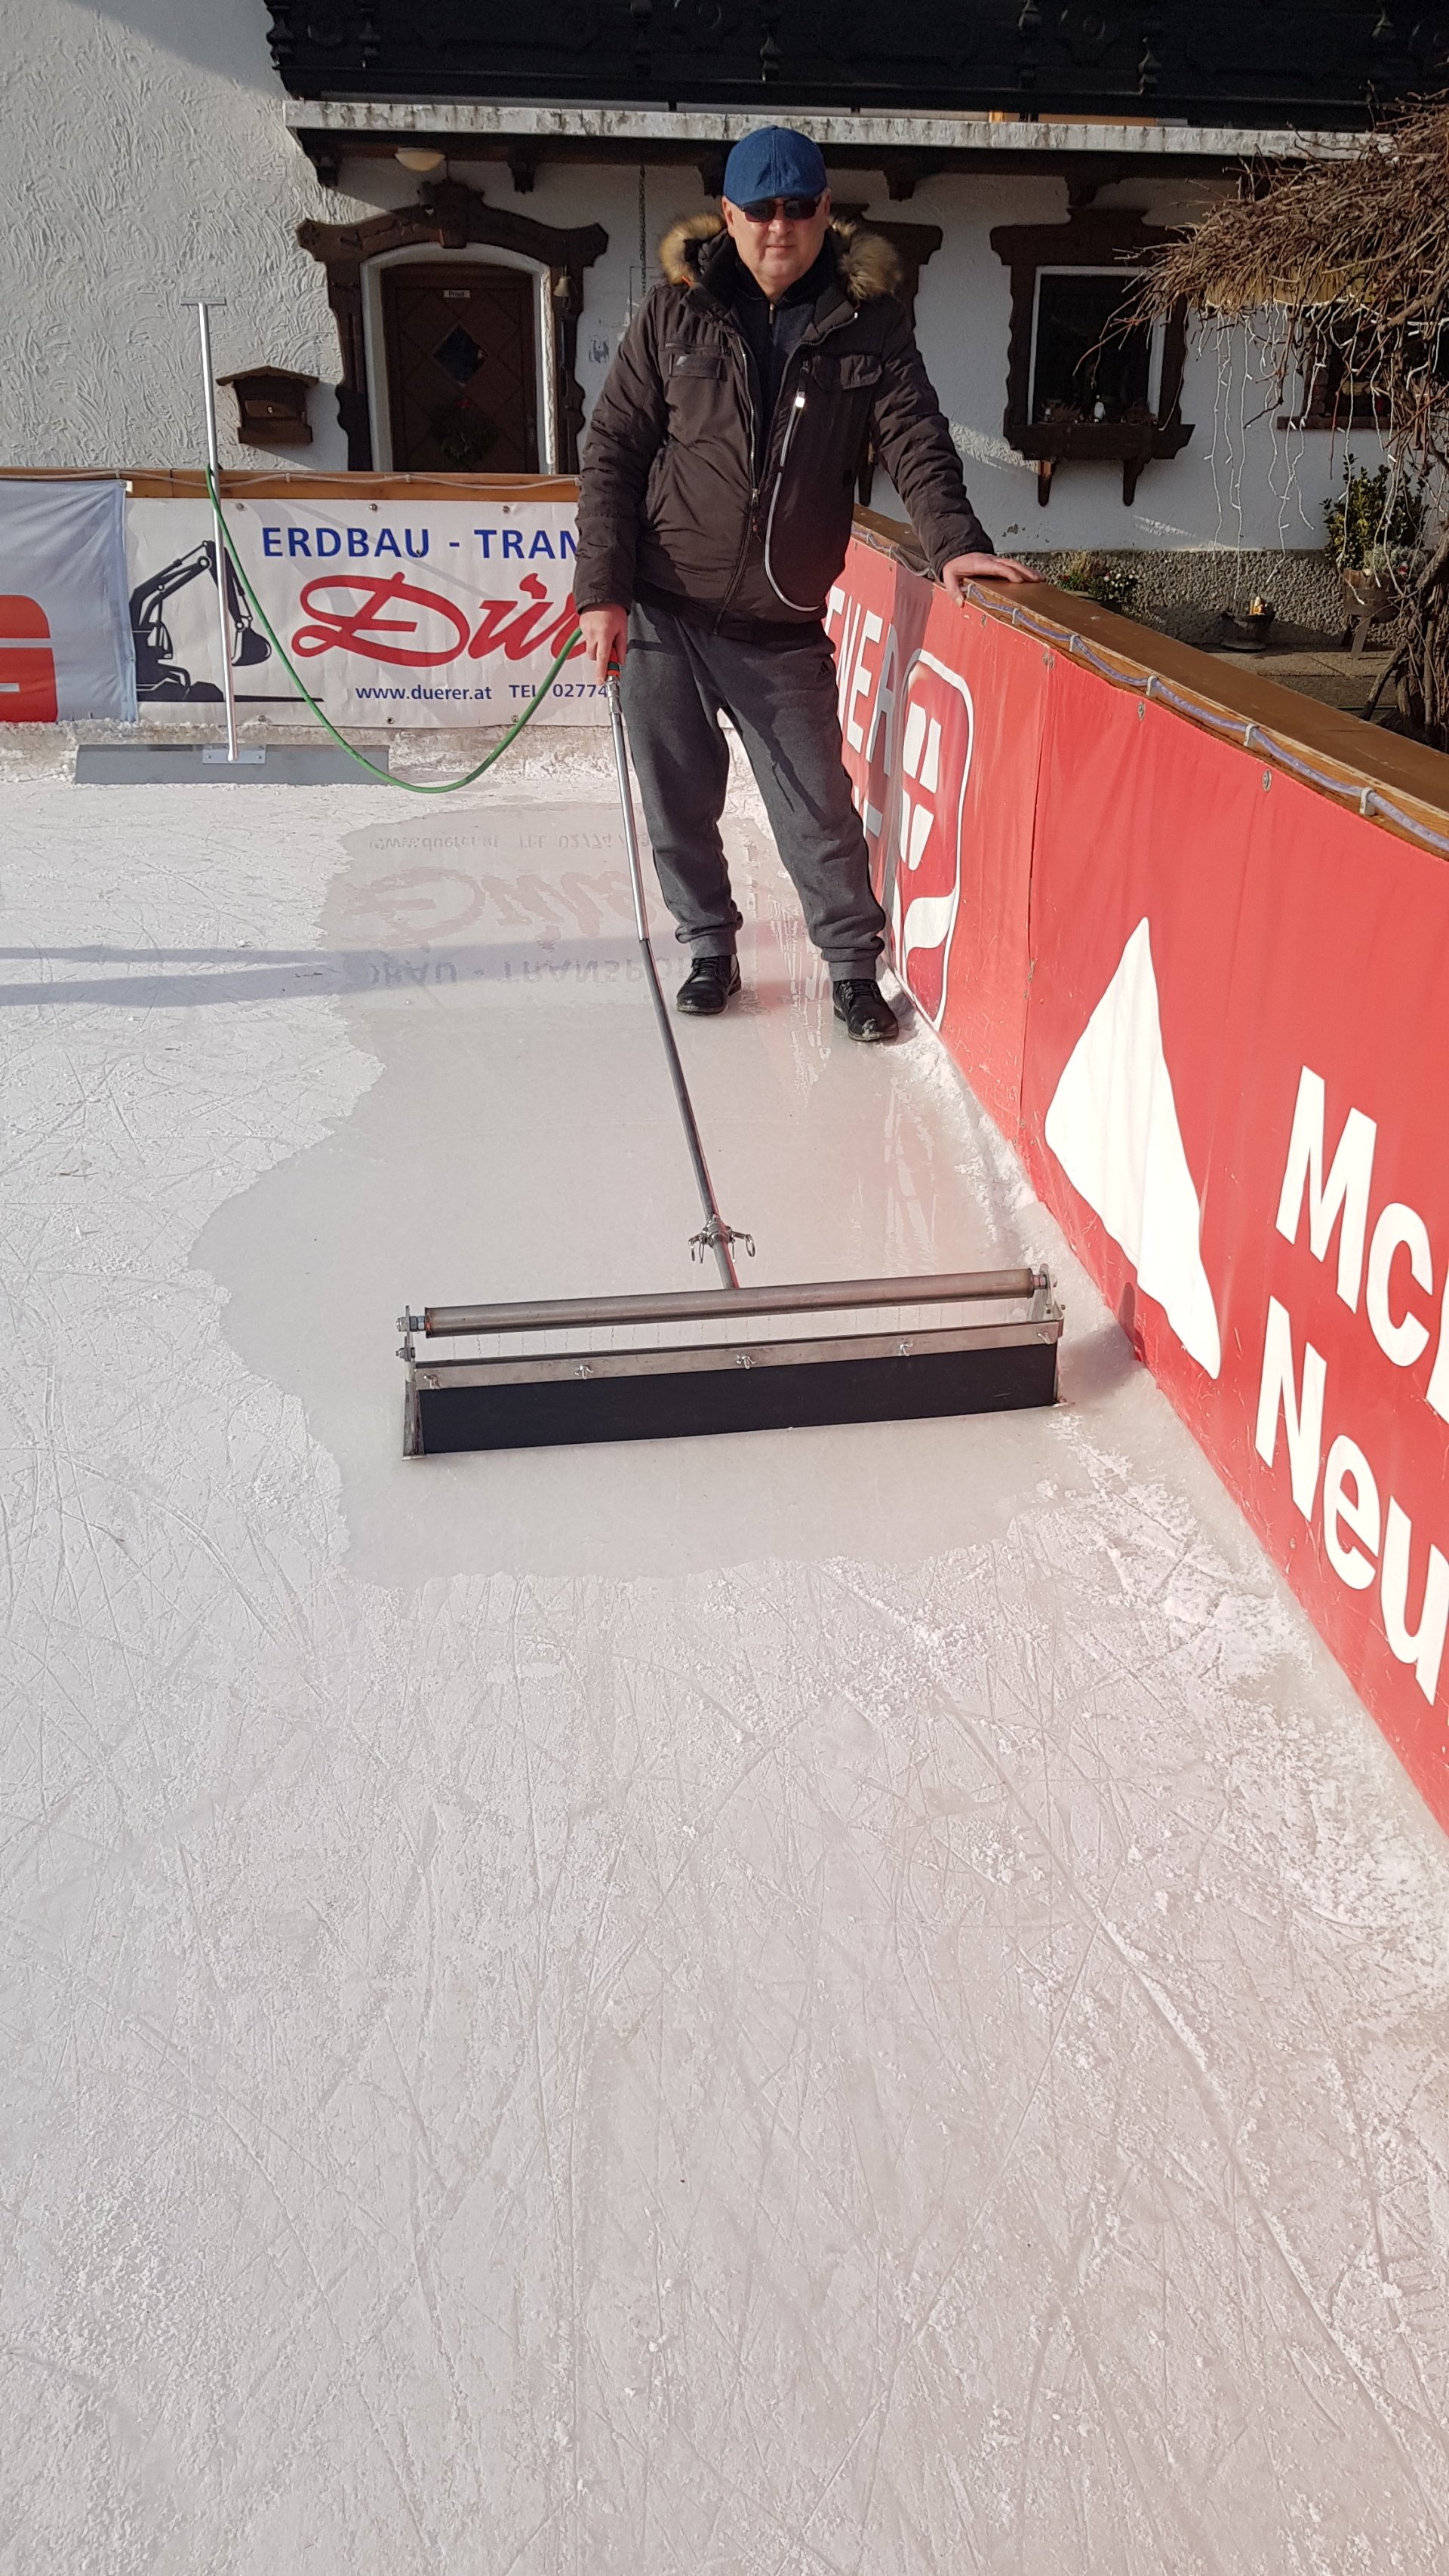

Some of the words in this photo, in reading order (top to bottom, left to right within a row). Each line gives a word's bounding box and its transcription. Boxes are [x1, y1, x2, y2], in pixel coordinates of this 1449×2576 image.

[262, 527, 429, 559] ERDBAU
[474, 529, 578, 559] TRAN
[355, 684, 492, 700] www.duerer.at
[1255, 1294, 1449, 1707] Neu
